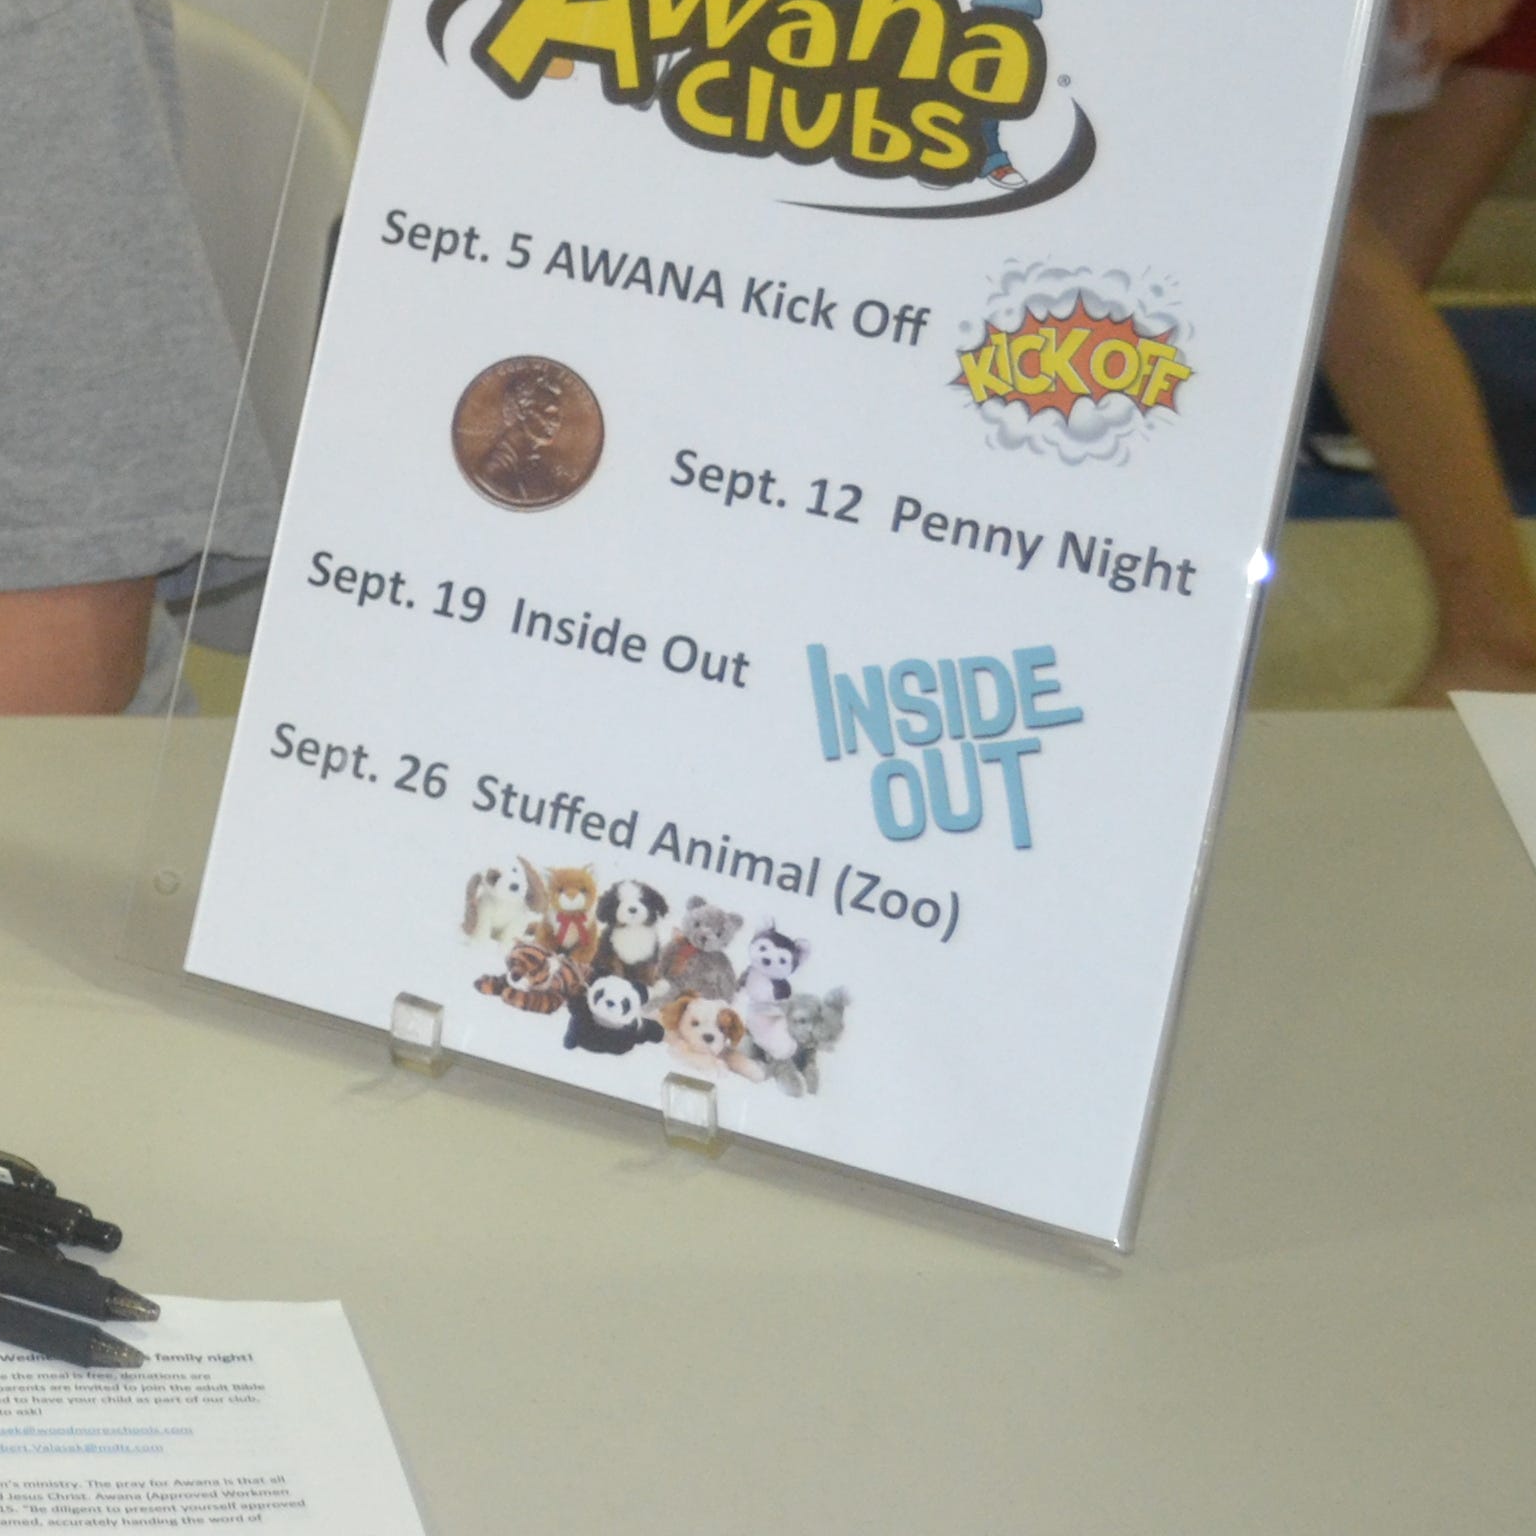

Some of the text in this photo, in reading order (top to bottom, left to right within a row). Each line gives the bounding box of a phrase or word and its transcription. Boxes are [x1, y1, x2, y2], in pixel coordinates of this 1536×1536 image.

[675, 57, 972, 172] Clubs
[380, 208, 930, 347] Sept. 5 AWANA Kick Off
[959, 327, 1193, 407] KICK OFF
[669, 448, 1197, 597] Sept. 12 Penny Night
[306, 550, 751, 689] Sept. 19 Inside Out
[806, 642, 1084, 762] INSIDE
[269, 722, 961, 944] Sept. 26 Stuffed Animal (Zoo)
[870, 737, 1042, 850] OUT
[11, 1372, 33, 1381] the
[73, 1372, 83, 1380] is
[87, 1371, 117, 1381] free,
[121, 1372, 186, 1381] donations
[191, 1372, 211, 1381] are
[14, 1396, 28, 1404] to
[32, 1396, 63, 1404] have
[67, 1396, 96, 1405] your
[101, 1395, 132, 1404] child
[137, 1396, 150, 1404] as
[154, 1396, 180, 1405] part
[185, 1395, 198, 1403] of
[203, 1396, 224, 1404] our
[50, 1385, 70, 1393] are
[74, 1383, 119, 1392] invited
[124, 1384, 137, 1392] to
[141, 1383, 166, 1393] join
[170, 1383, 191, 1392] the
[196, 1383, 227, 1392] adult
[232, 1383, 265, 1392] Bible
[155, 1353, 253, 1364] family night!
[0, 1409, 11, 1417] to
[87, 1480, 111, 1488] The
[116, 1480, 144, 1489] pray
[150, 1479, 168, 1488] for
[173, 1478, 219, 1487] Awana
[224, 1477, 233, 1486] is
[238, 1476, 265, 1485] that
[270, 1475, 285, 1484] all
